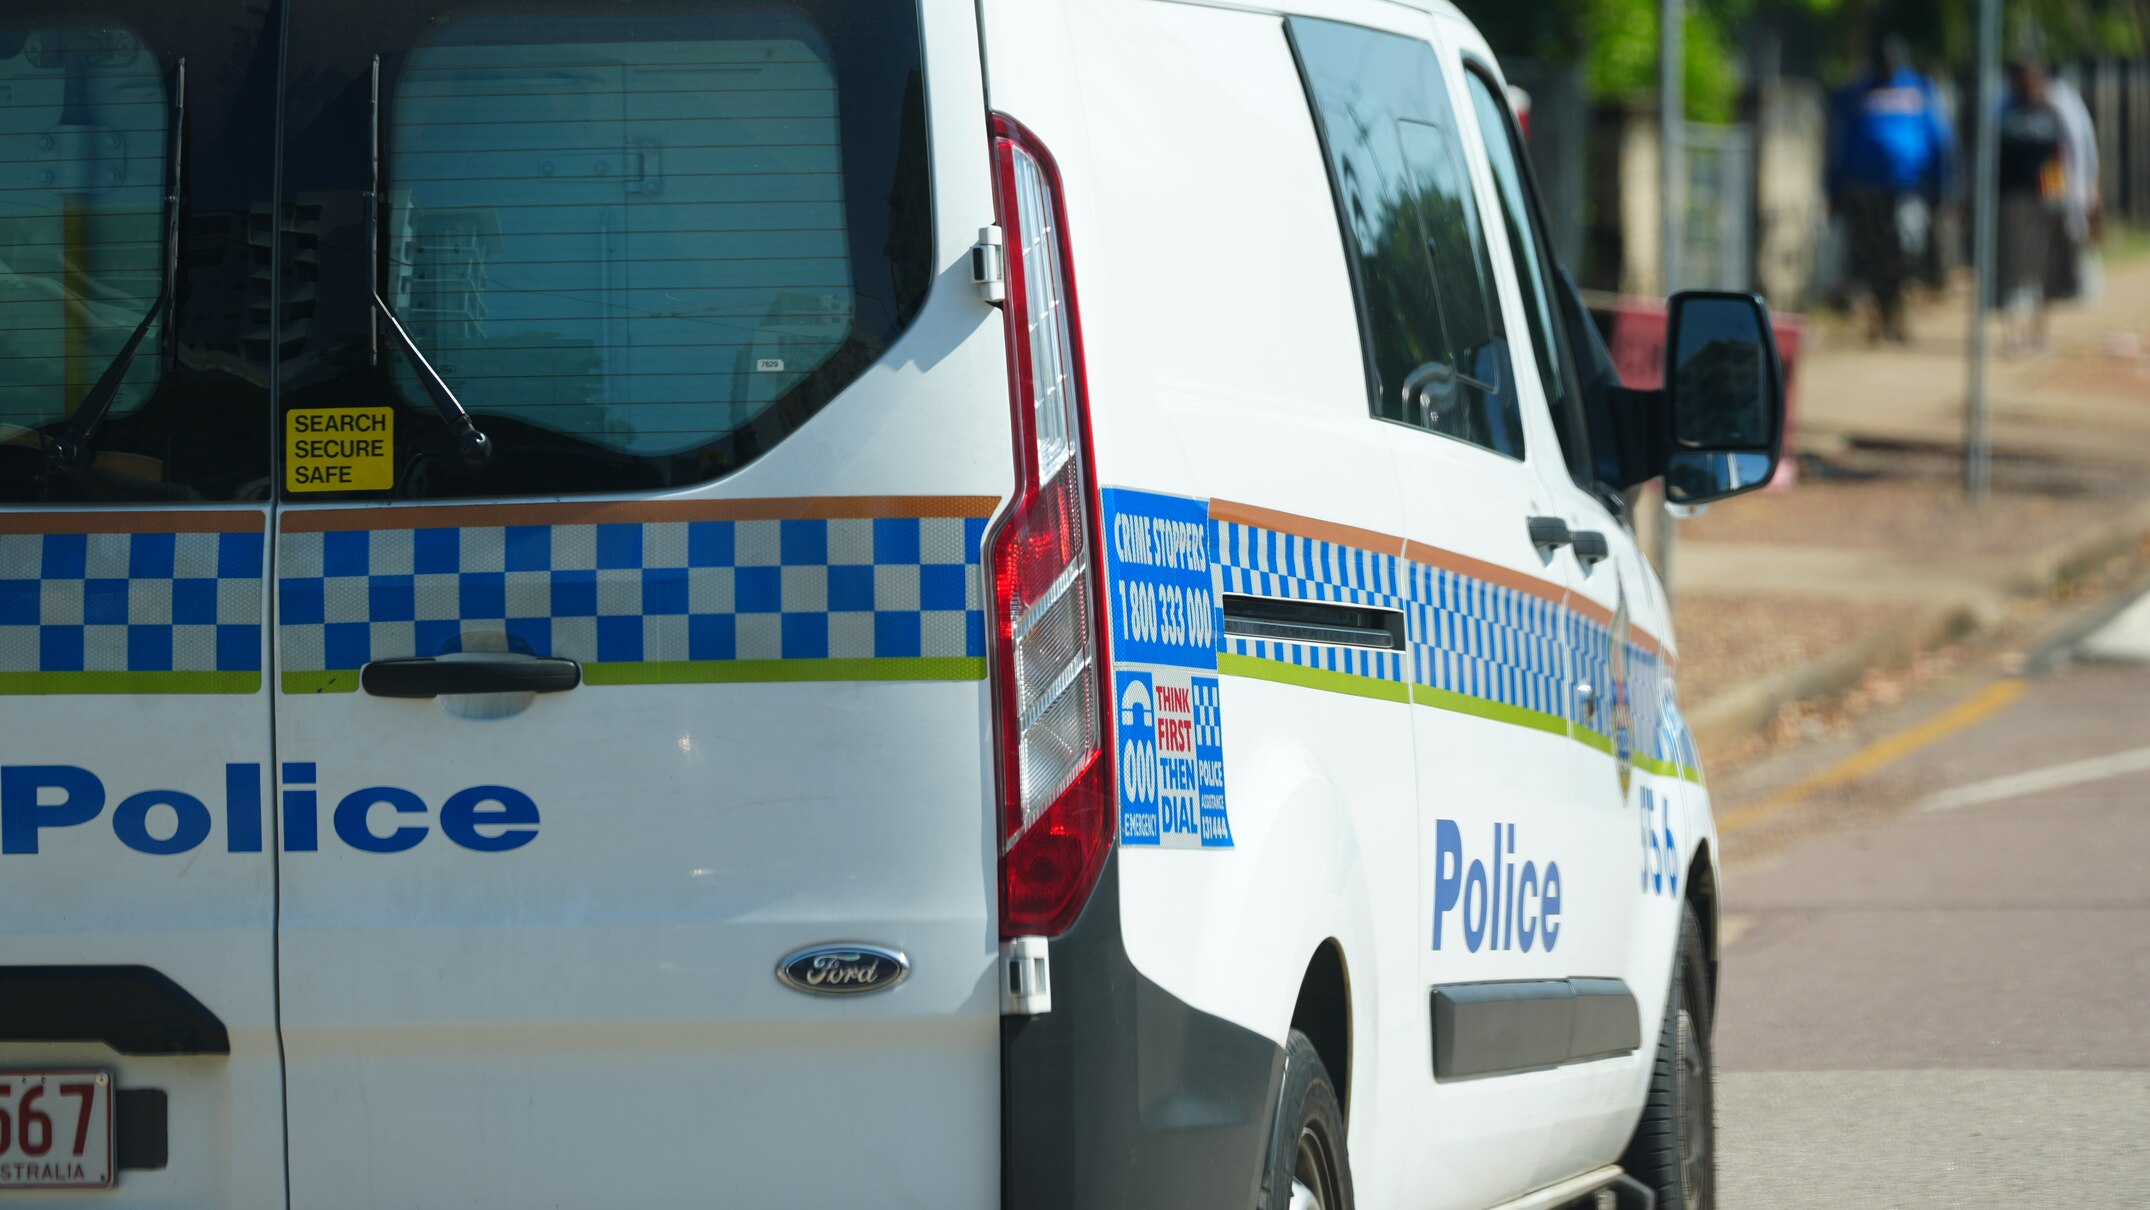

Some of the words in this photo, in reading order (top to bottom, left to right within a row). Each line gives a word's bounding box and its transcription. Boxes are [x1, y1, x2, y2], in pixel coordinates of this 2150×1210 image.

[294, 414, 386, 433] SEARCH
[294, 439, 385, 458] SECURE
[295, 465, 353, 484] SAFE
[1114, 512, 1153, 565] CRIME
[1153, 517, 1206, 573] STOPPERS
[1119, 579, 1129, 640] 1
[1130, 580, 1158, 643] 800
[1159, 583, 1185, 646] 333
[1186, 586, 1212, 649] 000
[1156, 686, 1190, 713] THINK
[1157, 718, 1192, 752] FIRST
[1124, 739, 1156, 804] 000
[1160, 757, 1196, 790] THEN
[1199, 759, 1223, 787] POLICE
[0, 762, 541, 854] Police
[1124, 812, 1157, 837] EMERGENCY
[1162, 796, 1198, 834] DIAL
[1432, 819, 1561, 953] Police
[806, 953, 880, 985] Ford
